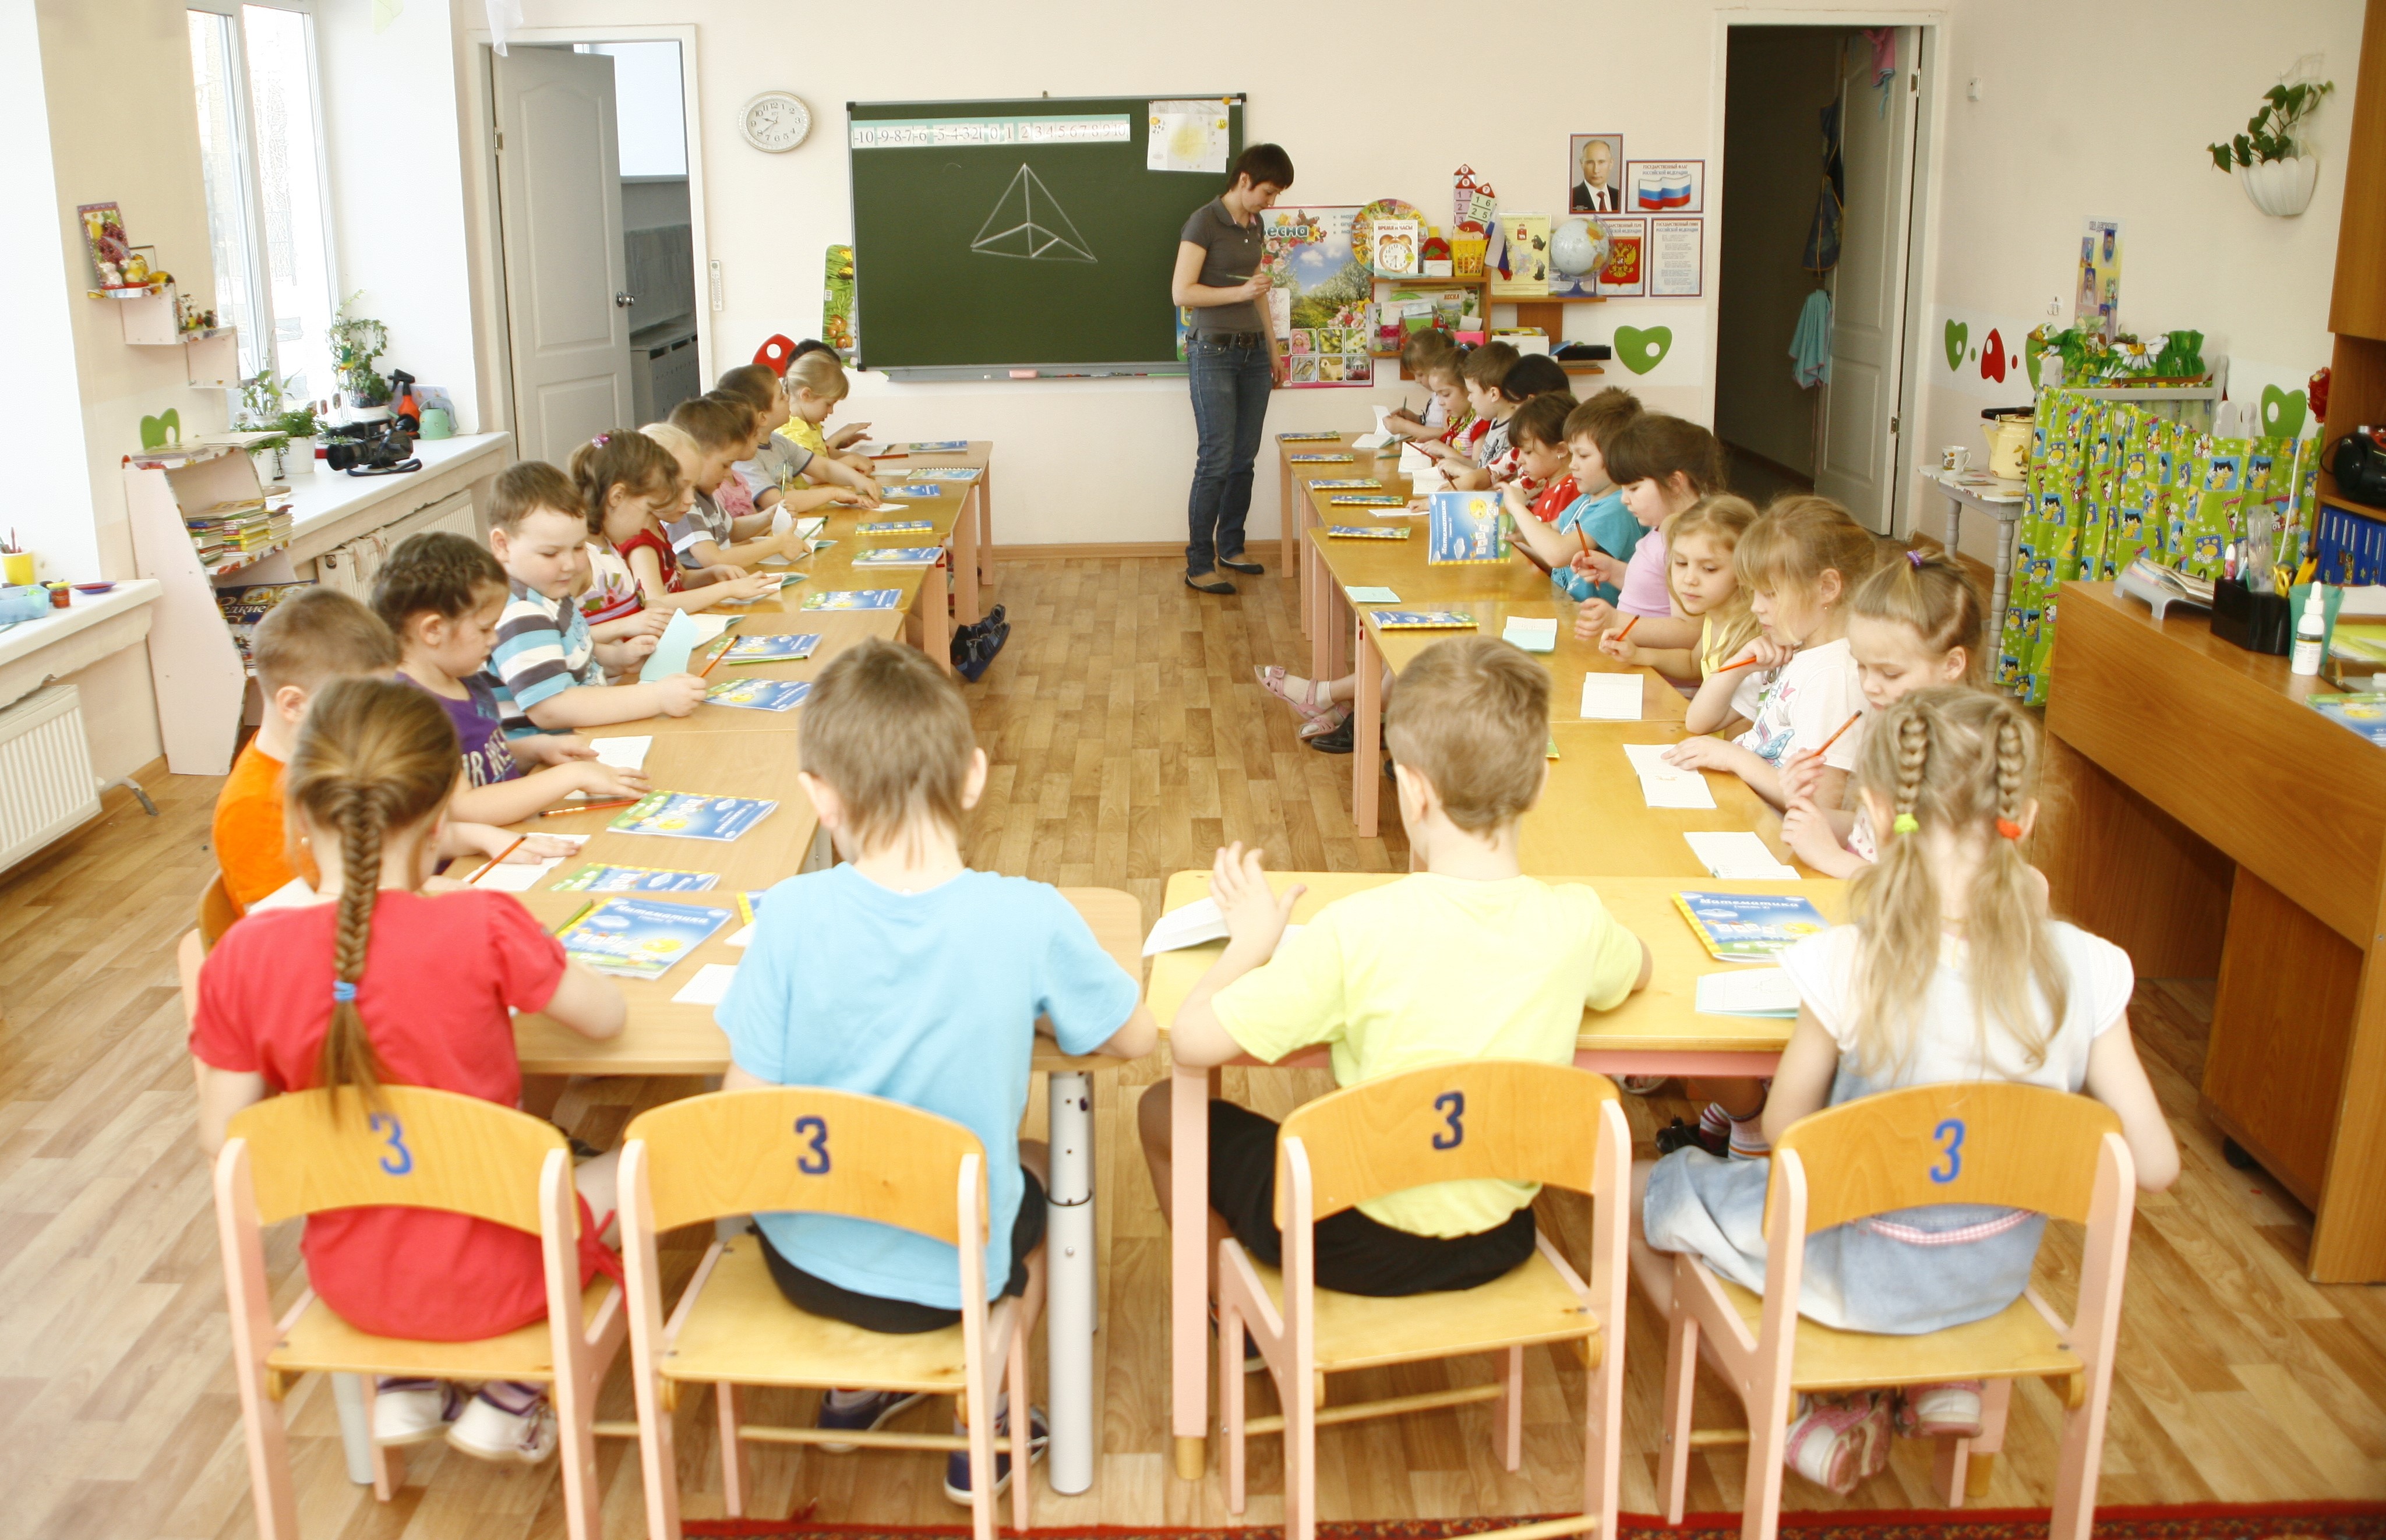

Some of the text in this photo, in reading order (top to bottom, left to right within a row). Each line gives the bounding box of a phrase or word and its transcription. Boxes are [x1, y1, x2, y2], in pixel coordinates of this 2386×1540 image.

[854, 131, 874, 143] -10
[877, 130, 889, 142] -9
[890, 130, 902, 142] -8
[903, 129, 912, 142] -7
[914, 129, 927, 141] -6
[990, 127, 997, 139] 0
[1008, 126, 1012, 139] 1
[1021, 126, 1028, 138] 2
[1035, 126, 1042, 138] 3
[1046, 126, 1053, 137] 4
[1058, 126, 1065, 137] 5
[1070, 125, 1077, 137] 6
[1079, 125, 1086, 137] 7
[1092, 125, 1099, 136] 8
[1103, 125, 1110, 136] 9
[1700, 898, 1799, 907] Математика
[370, 1112, 414, 1176] 3
[795, 1115, 831, 1175] 3
[1432, 1091, 1464, 1151] 3
[1930, 1118, 1966, 1184] 3
